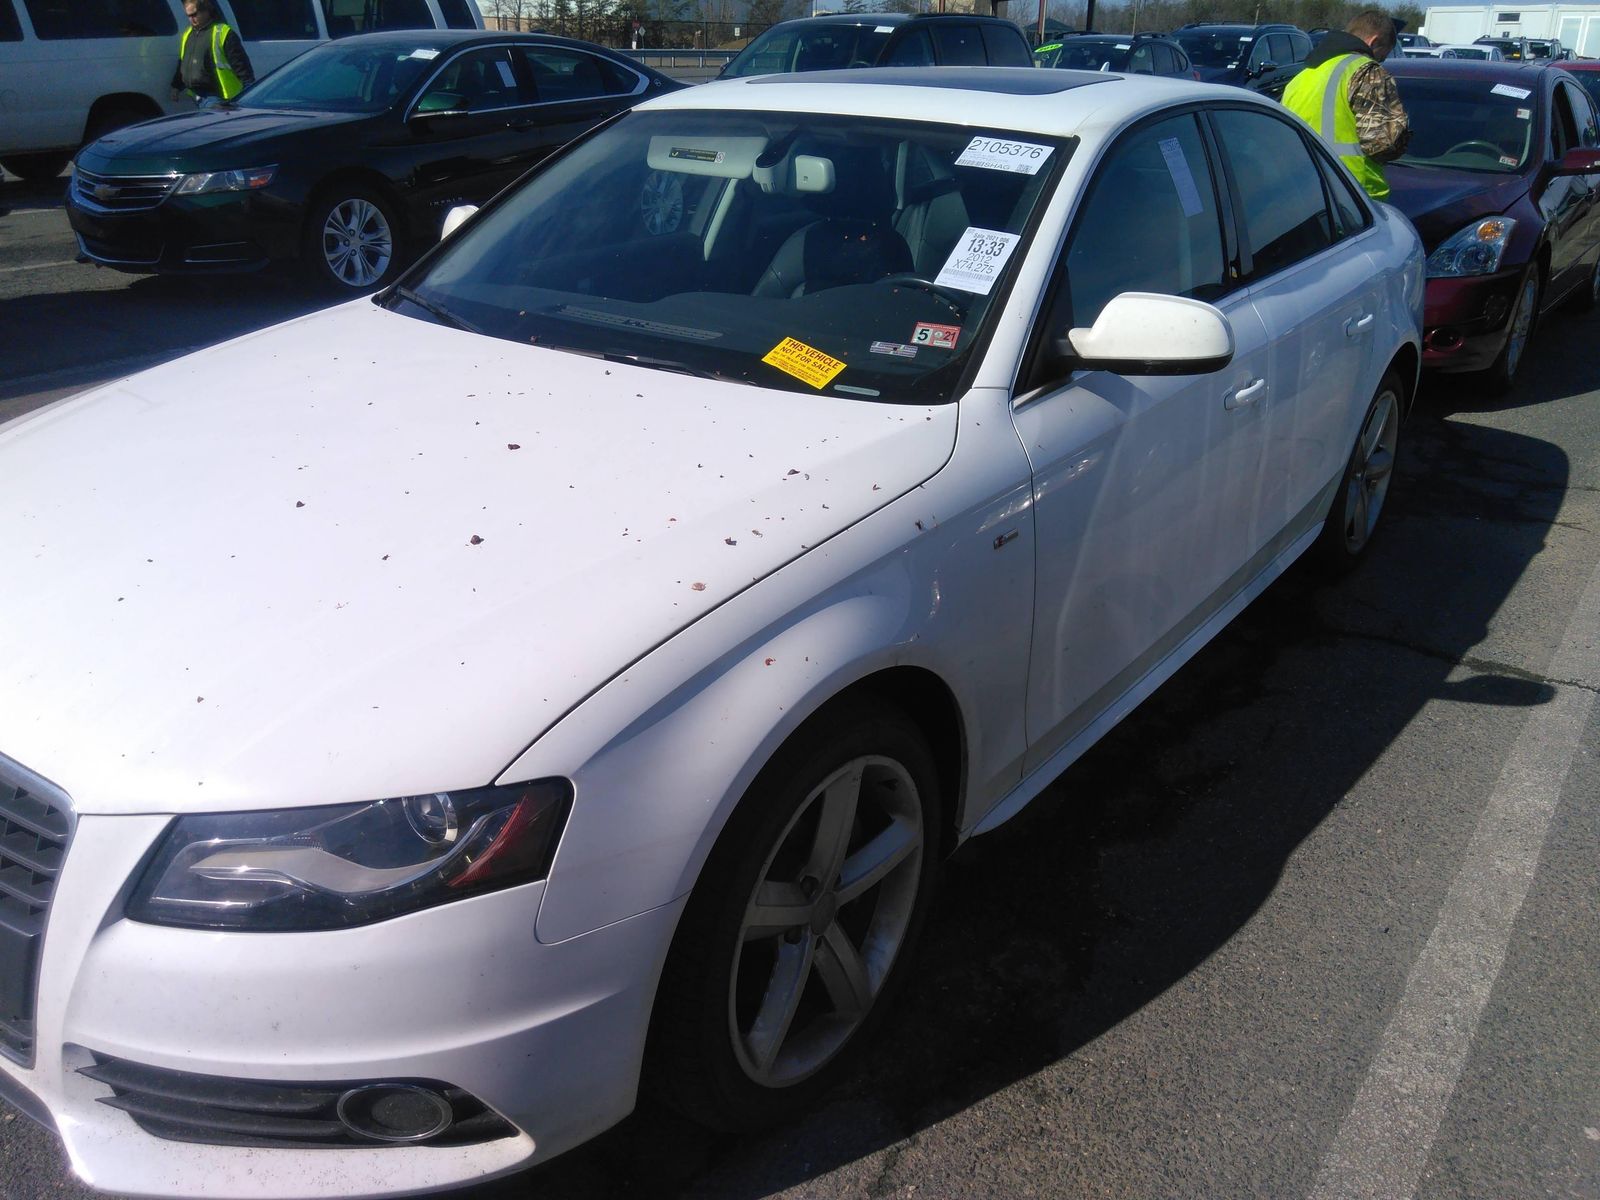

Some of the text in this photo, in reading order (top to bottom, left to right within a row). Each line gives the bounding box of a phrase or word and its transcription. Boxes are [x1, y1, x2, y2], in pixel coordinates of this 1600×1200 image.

[967, 140, 1043, 159] 2105376
[967, 238, 1005, 257] 13:33
[966, 252, 993, 265] 2012
[917, 328, 929, 341] 5
[943, 331, 956, 341] 21
[780, 346, 796, 357] NOT
[796, 353, 811, 365] FOR
[812, 361, 832, 374] SALE
[785, 339, 805, 352] THIS
[805, 348, 841, 370] VEHICLE
